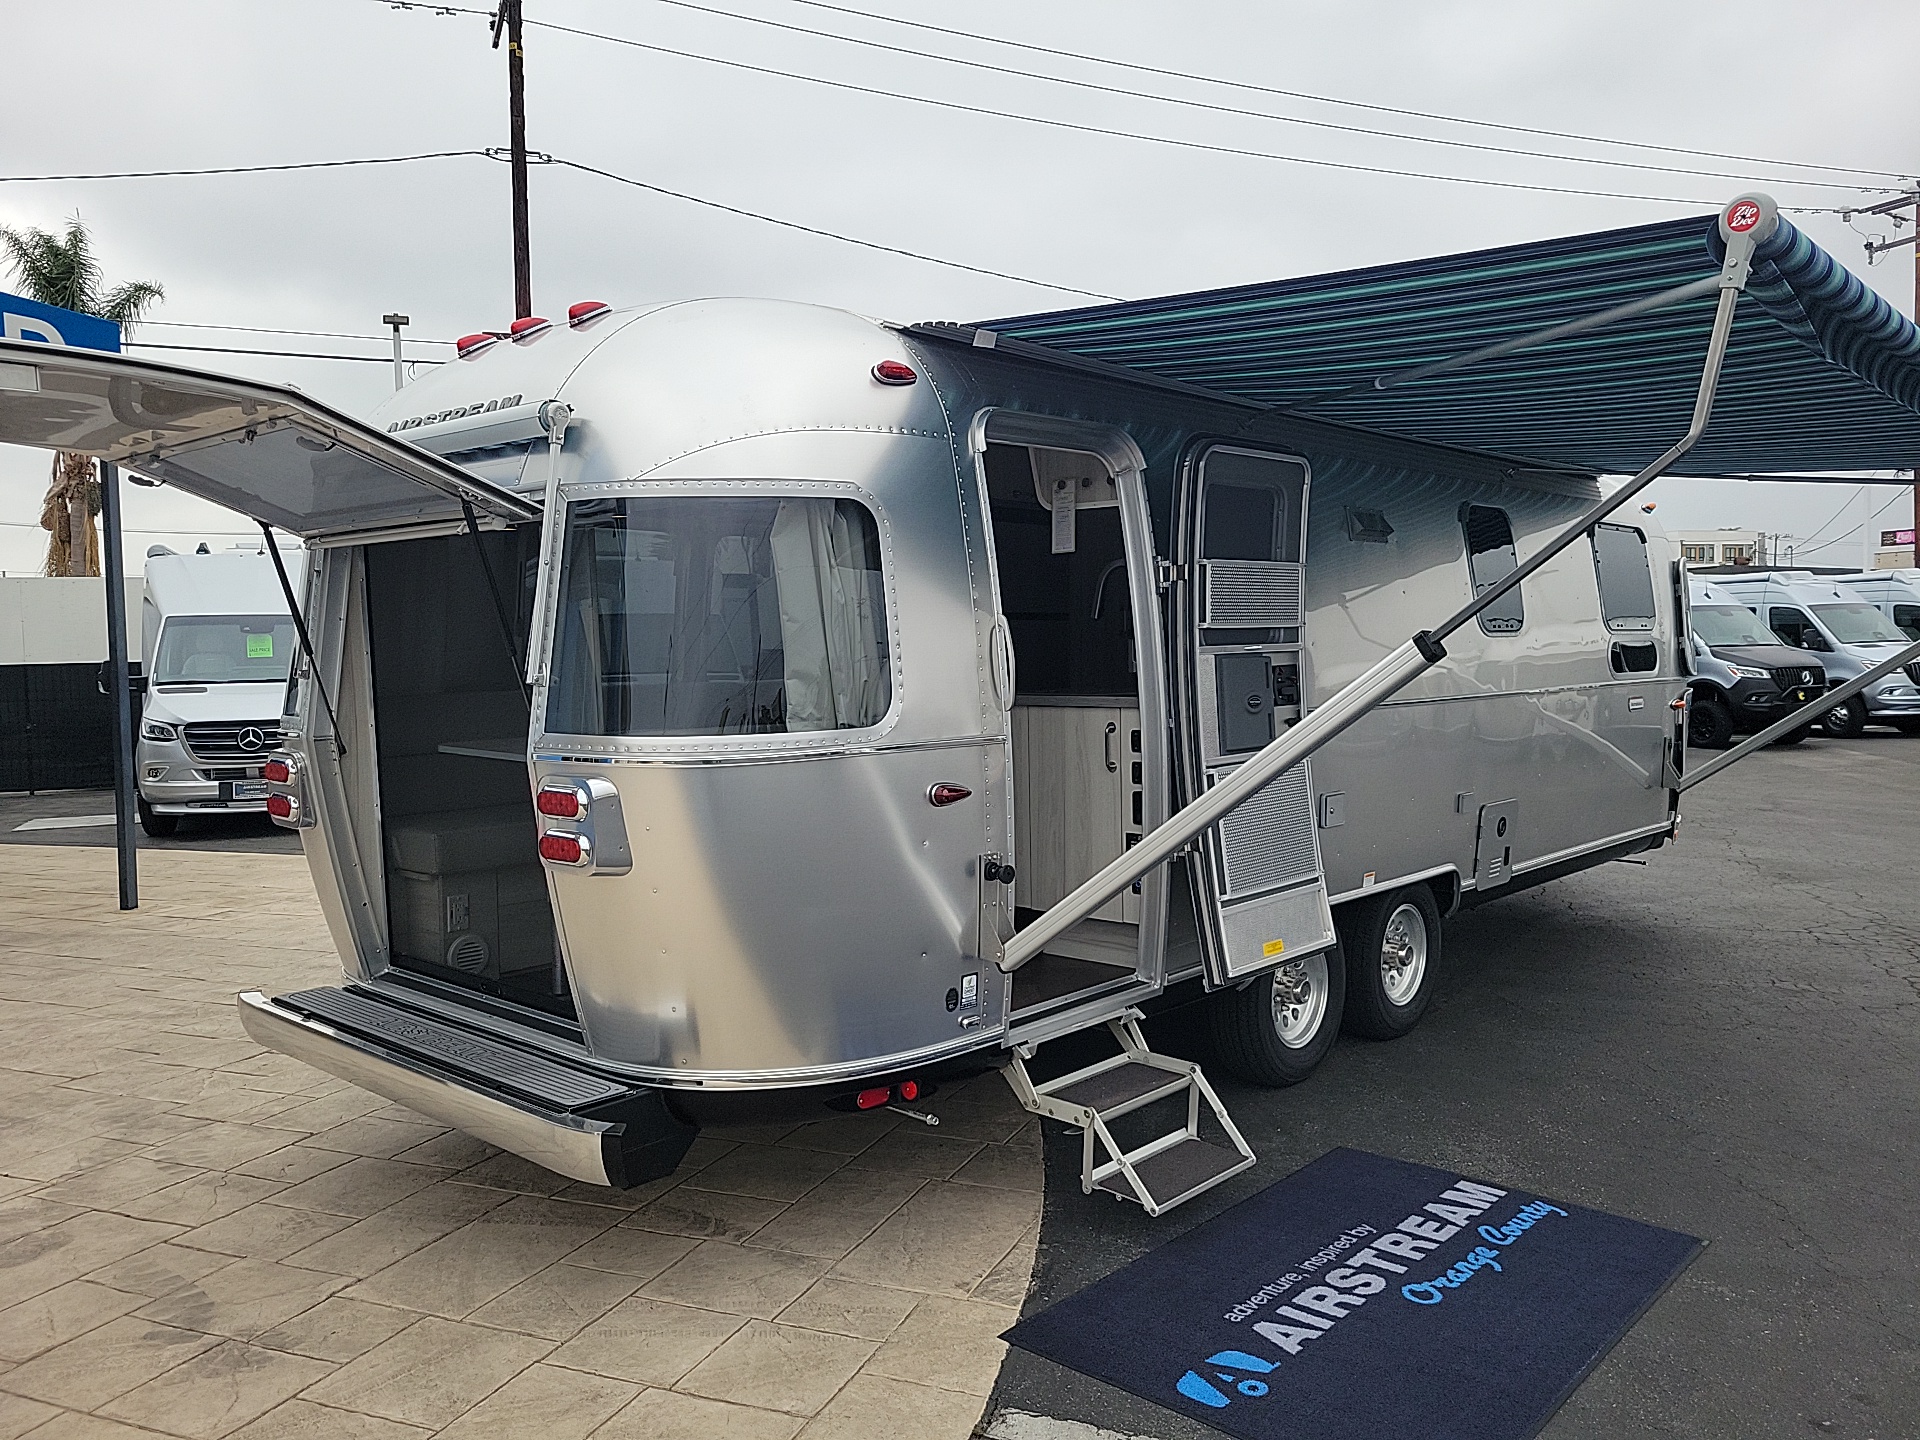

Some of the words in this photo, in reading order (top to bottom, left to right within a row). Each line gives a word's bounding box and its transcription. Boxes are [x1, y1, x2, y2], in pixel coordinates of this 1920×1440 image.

[386, 393, 523, 433] AIRSTREAM
[1222, 1272, 1312, 1323] adventure,
[1294, 1234, 1358, 1272] inspired
[1344, 1223, 1377, 1237] by
[1251, 1179, 1509, 1356] AIRSTREAM
[1401, 1246, 1503, 1305] Orange
[1477, 1200, 1569, 1246] County
